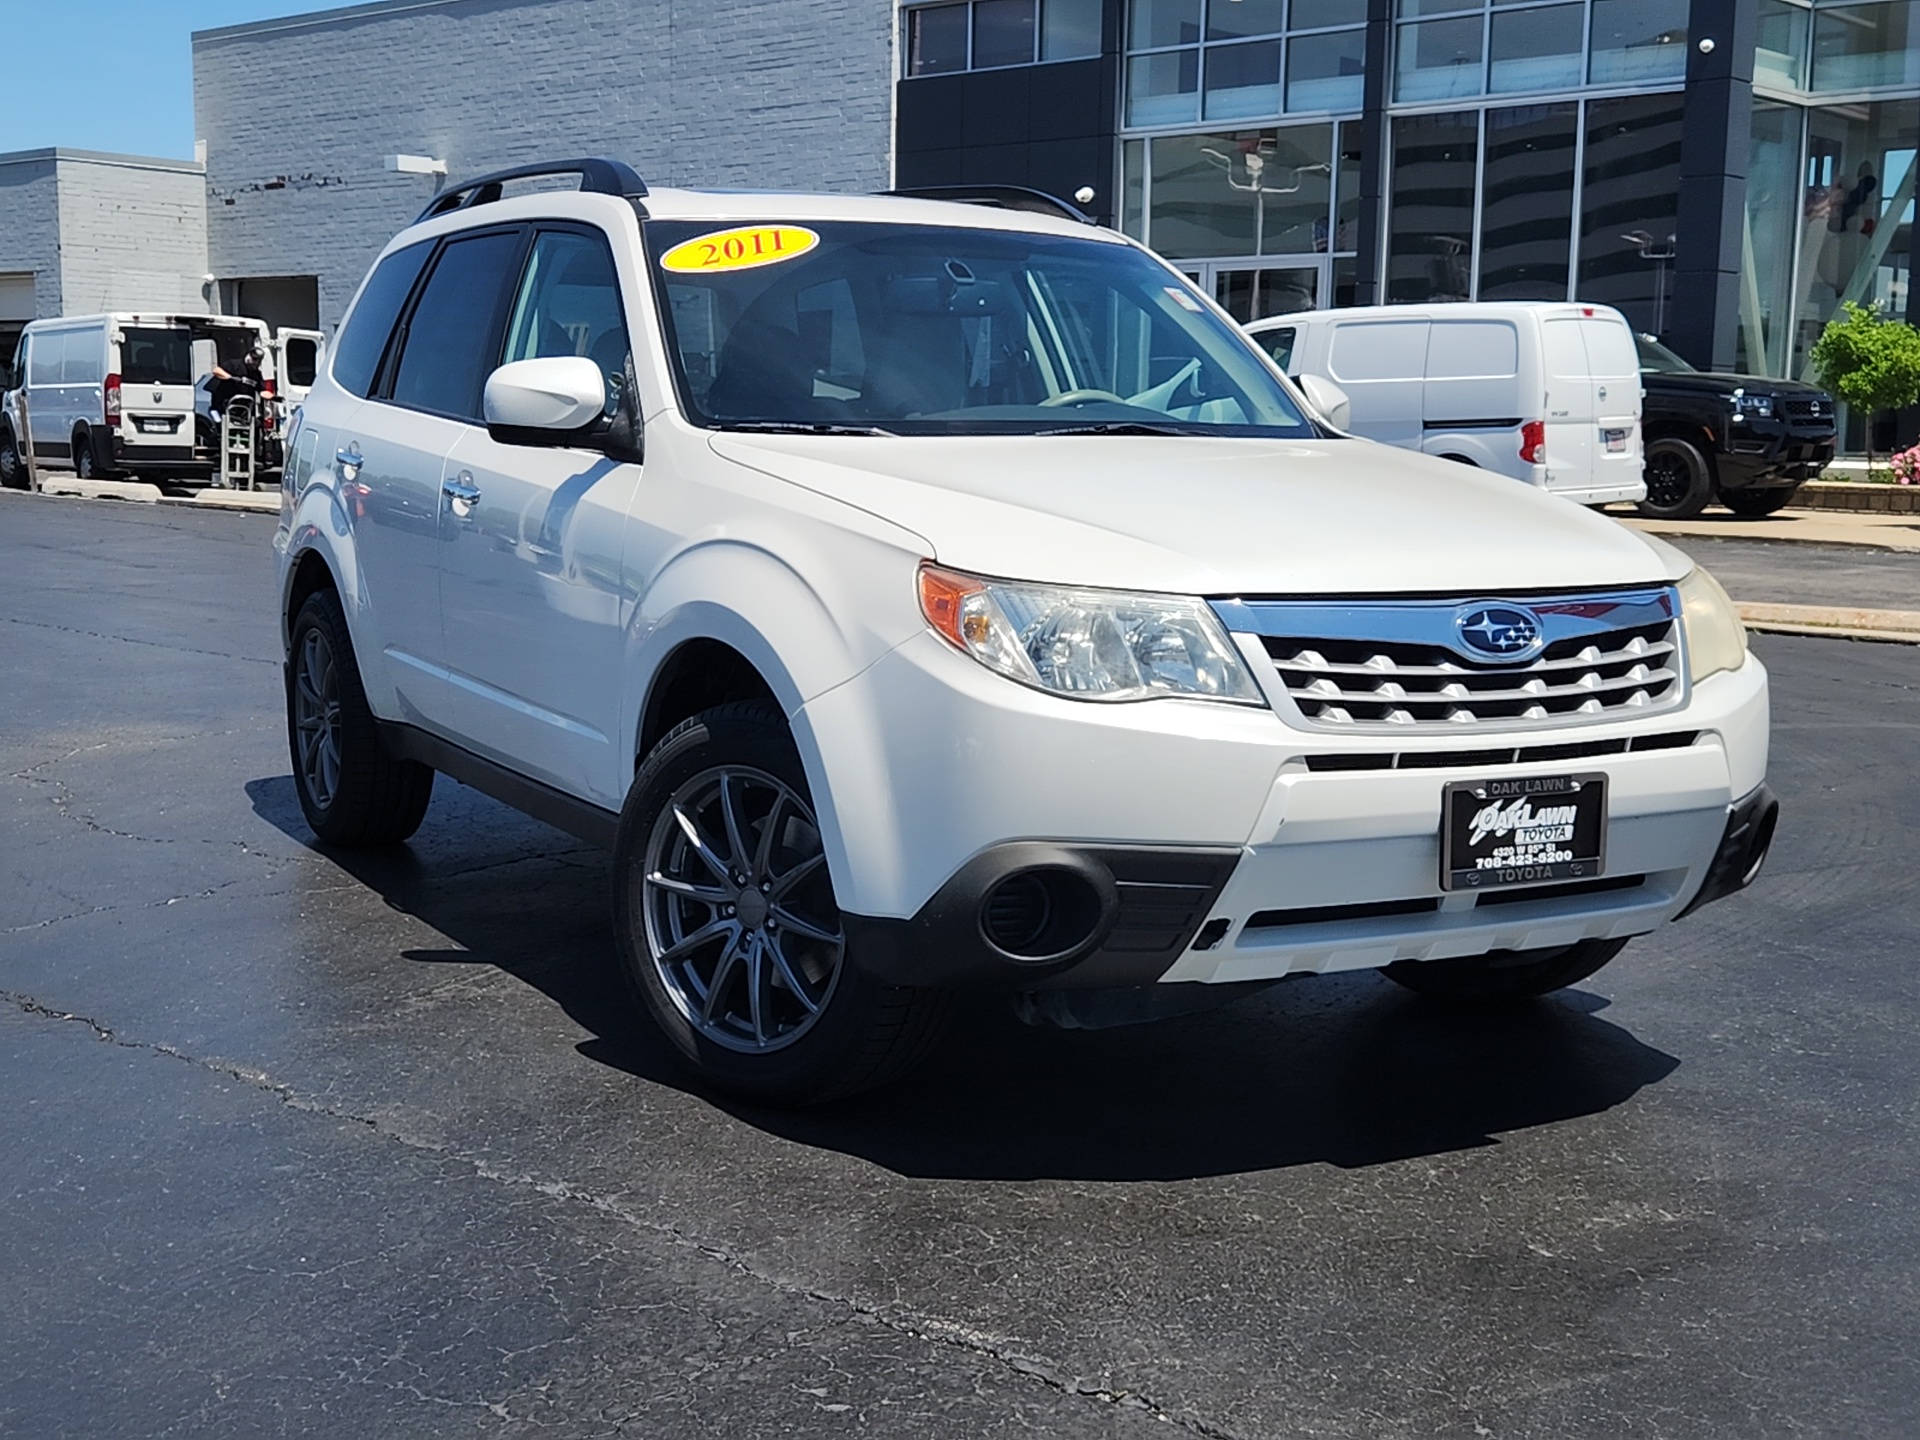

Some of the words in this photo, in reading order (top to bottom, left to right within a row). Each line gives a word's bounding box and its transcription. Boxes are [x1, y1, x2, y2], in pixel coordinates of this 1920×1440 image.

[699, 230, 785, 266] 2011
[1492, 781, 1520, 794] OAK
[1525, 778, 1565, 791] LAWN
[1523, 827, 1566, 841] TOYOTA
[1516, 845, 1526, 855] W
[1475, 850, 1573, 869] 708-423-5200
[1497, 866, 1553, 883] TOYOTA
